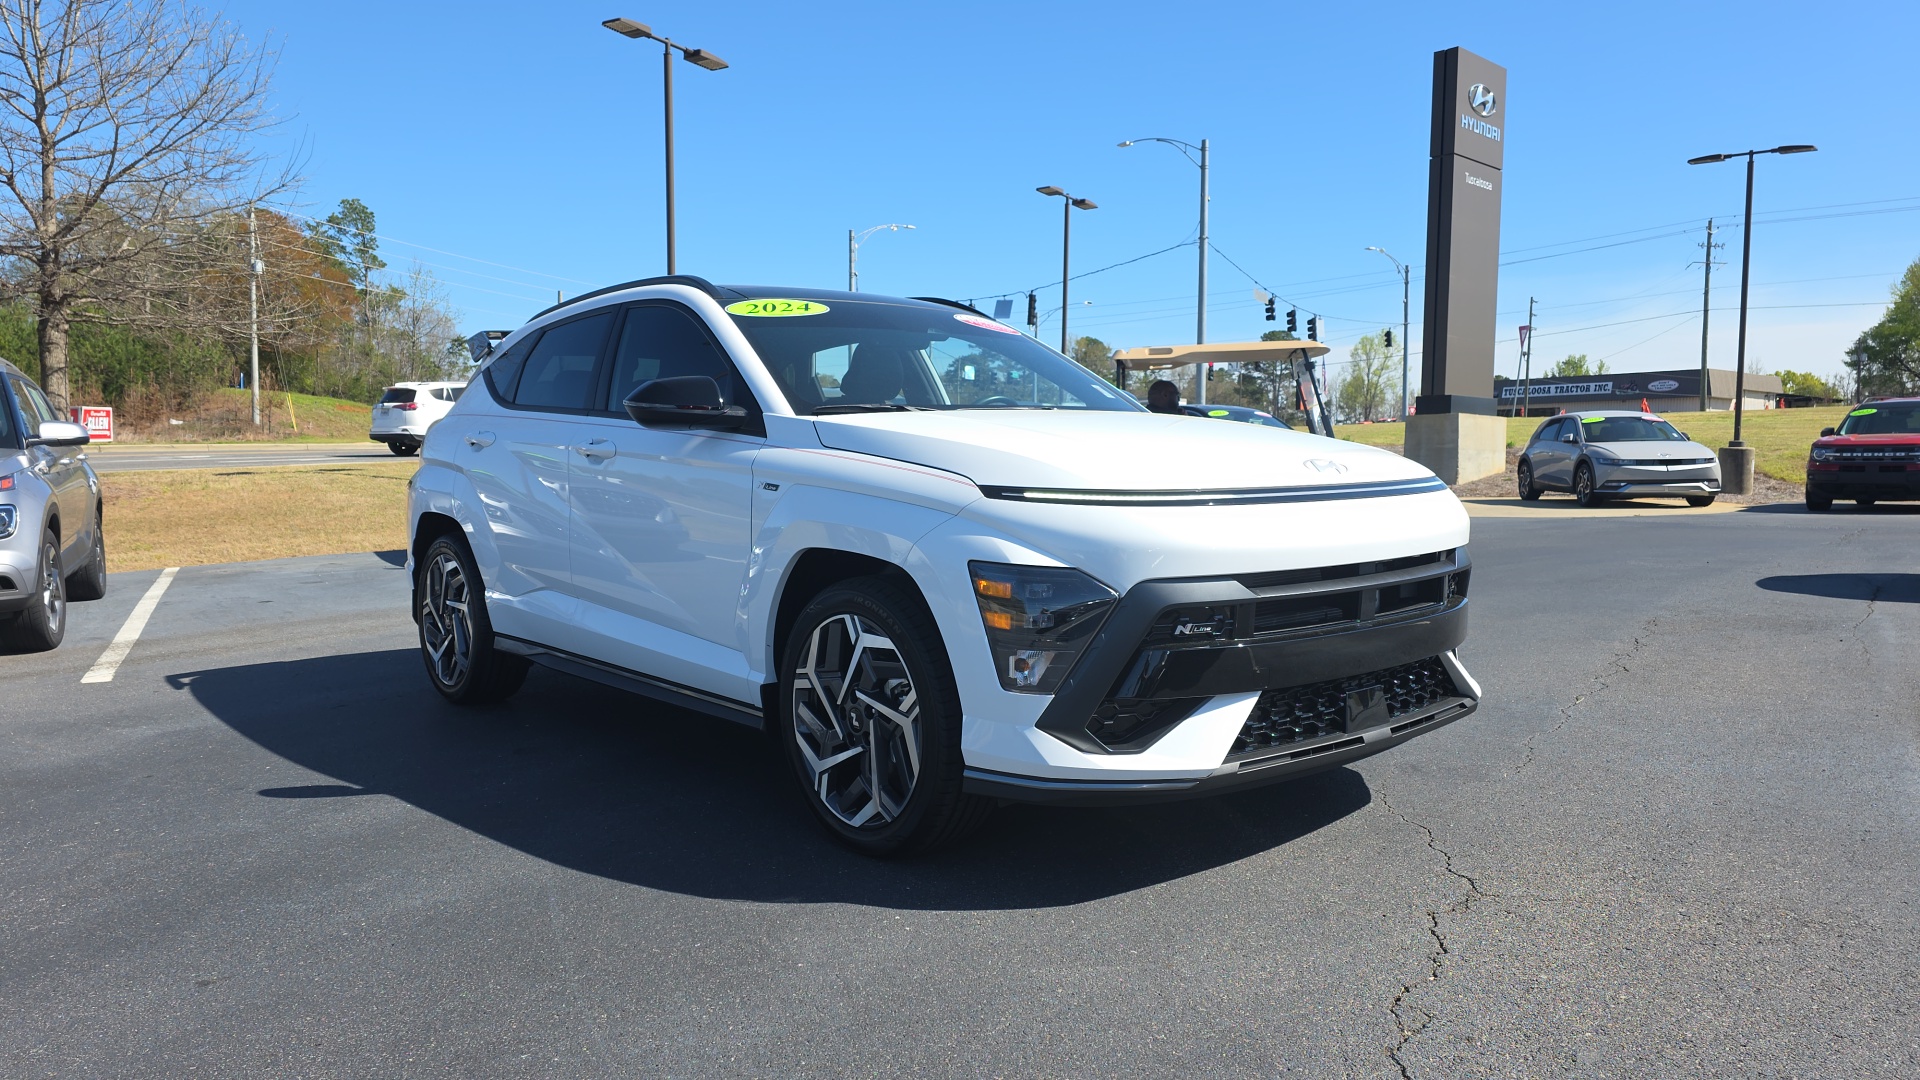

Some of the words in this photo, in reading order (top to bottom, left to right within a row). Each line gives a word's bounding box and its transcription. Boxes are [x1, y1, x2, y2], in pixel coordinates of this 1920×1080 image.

[1461, 114, 1501, 142] HYUNDAI
[1465, 171, 1493, 191] Tuscaloosa
[745, 302, 811, 315] 2024
[1554, 384, 1591, 394] TRACTOR
[1593, 383, 1611, 392] INC.
[853, 595, 902, 635] IRONMAN
[1174, 623, 1193, 635] N
